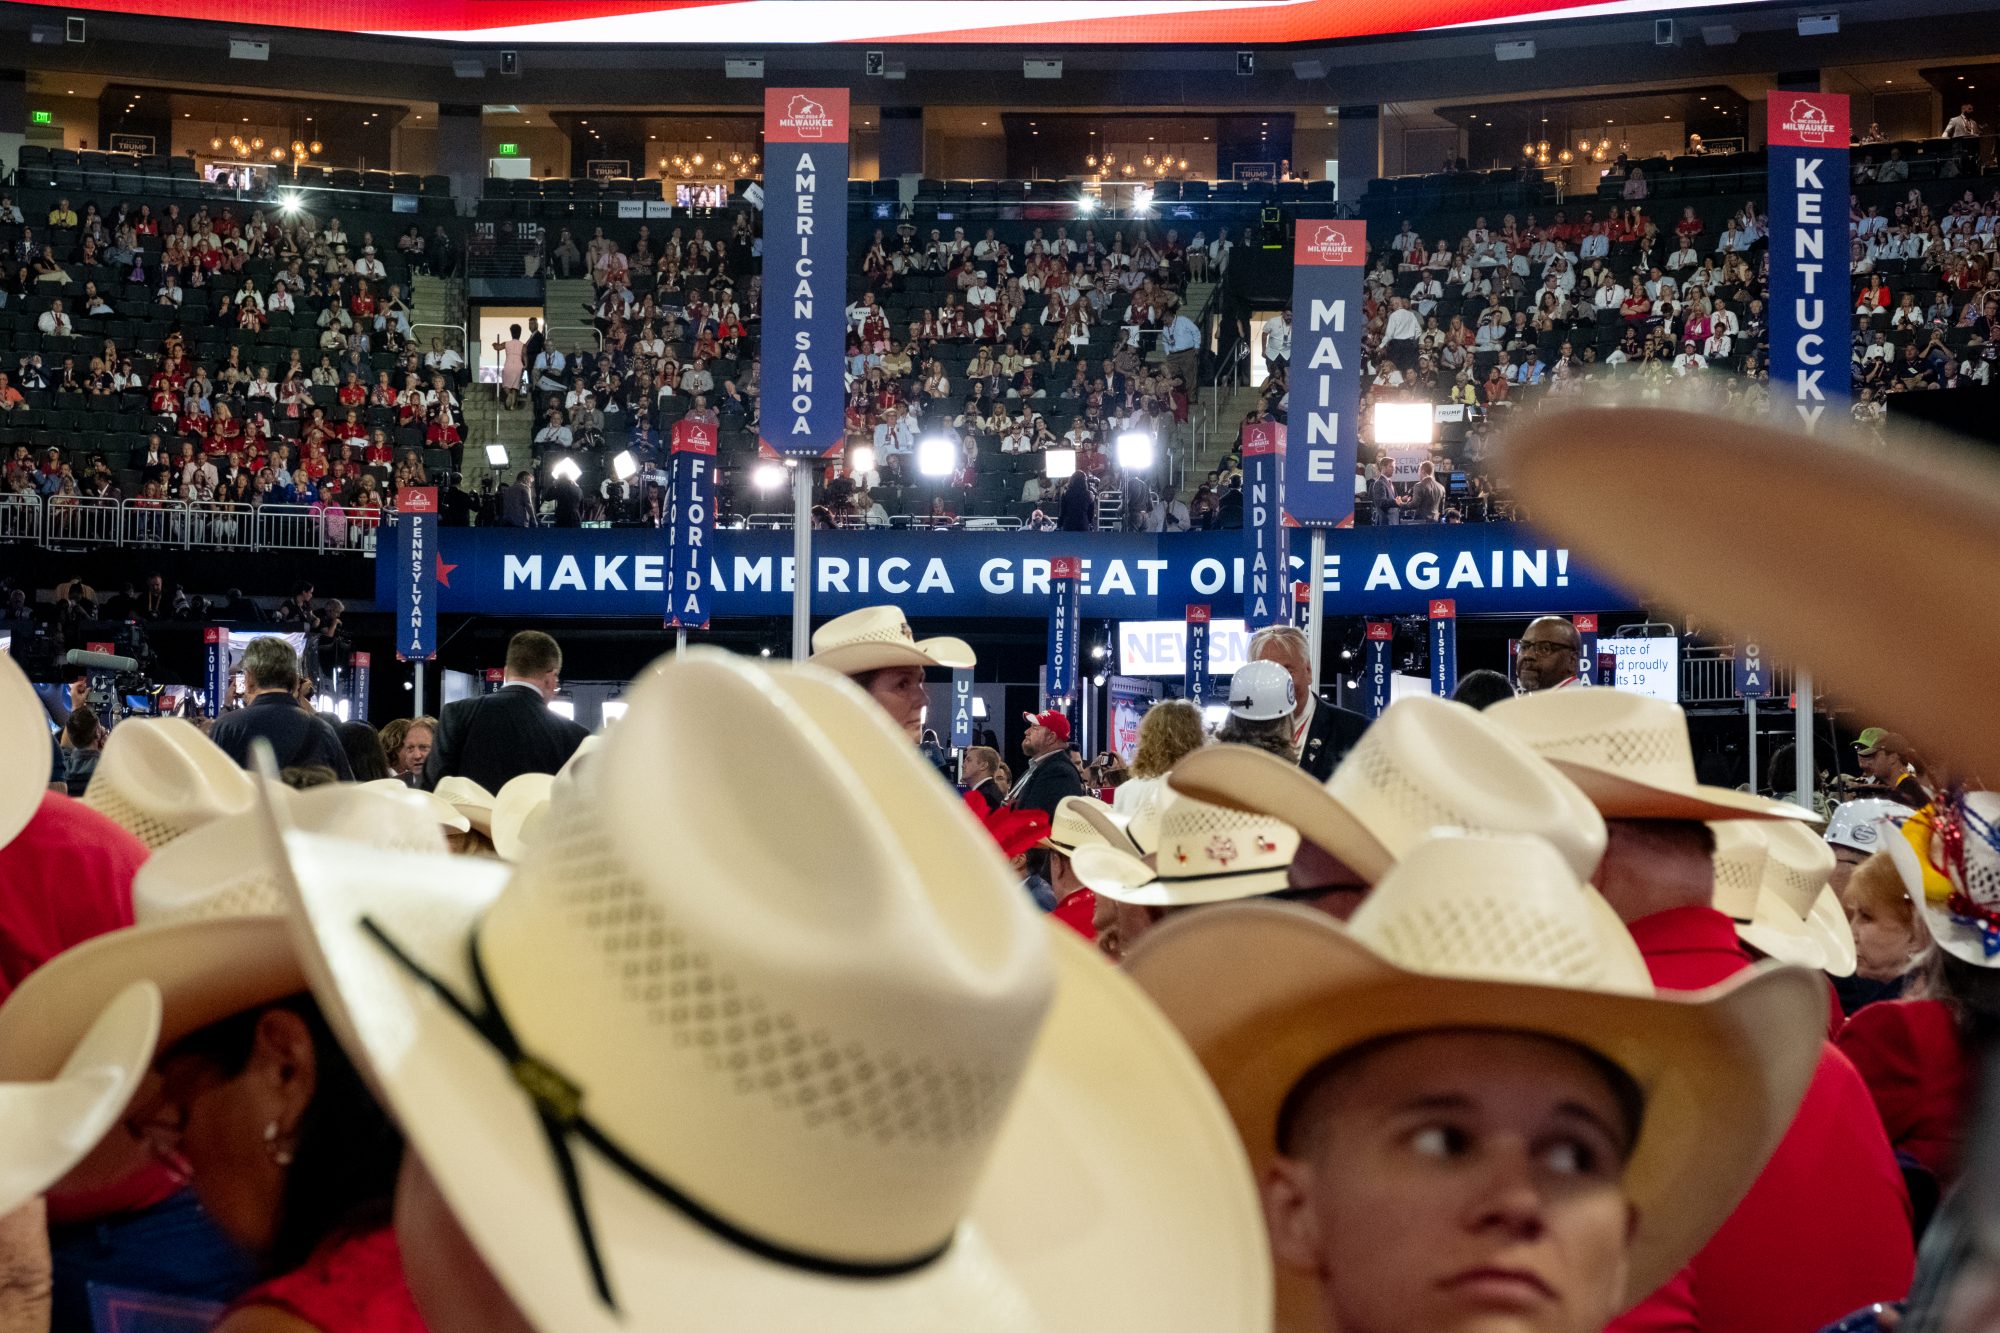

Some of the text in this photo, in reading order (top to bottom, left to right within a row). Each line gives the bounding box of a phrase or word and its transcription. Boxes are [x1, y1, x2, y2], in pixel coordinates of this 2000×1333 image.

[36, 112, 49, 122] EXIT
[1782, 122, 1835, 133] MILWAUKEE
[118, 142, 147, 150] TRUMP
[503, 144, 514, 153] EXIT
[517, 222, 537, 239] 112
[791, 152, 816, 435] AMERICAN SAMOA
[1796, 158, 1826, 436] KENTUCKY
[1307, 299, 1346, 482] MAINE
[1395, 465, 1419, 474] NEW
[666, 459, 678, 613] FLORIDA
[684, 459, 705, 614] FLORIDA
[1252, 461, 1268, 617] INDIANA
[411, 516, 423, 650] PENNSYLVANIA
[503, 554, 665, 591] MAKE
[1364, 549, 1569, 591] AGAIN!
[1053, 582, 1066, 690] MINNESOTA
[1437, 621, 1446, 699] MISSISSIP
[1608, 644, 1636, 655] State
[1639, 644, 1651, 655] of
[1192, 626, 1203, 704] MICHIGA
[1374, 641, 1384, 717] VIRGINI
[1579, 643, 1592, 687] IDA
[1616, 674, 1646, 686] its 19
[1628, 659, 1669, 672] proudly
[956, 680, 969, 734] UTAH
